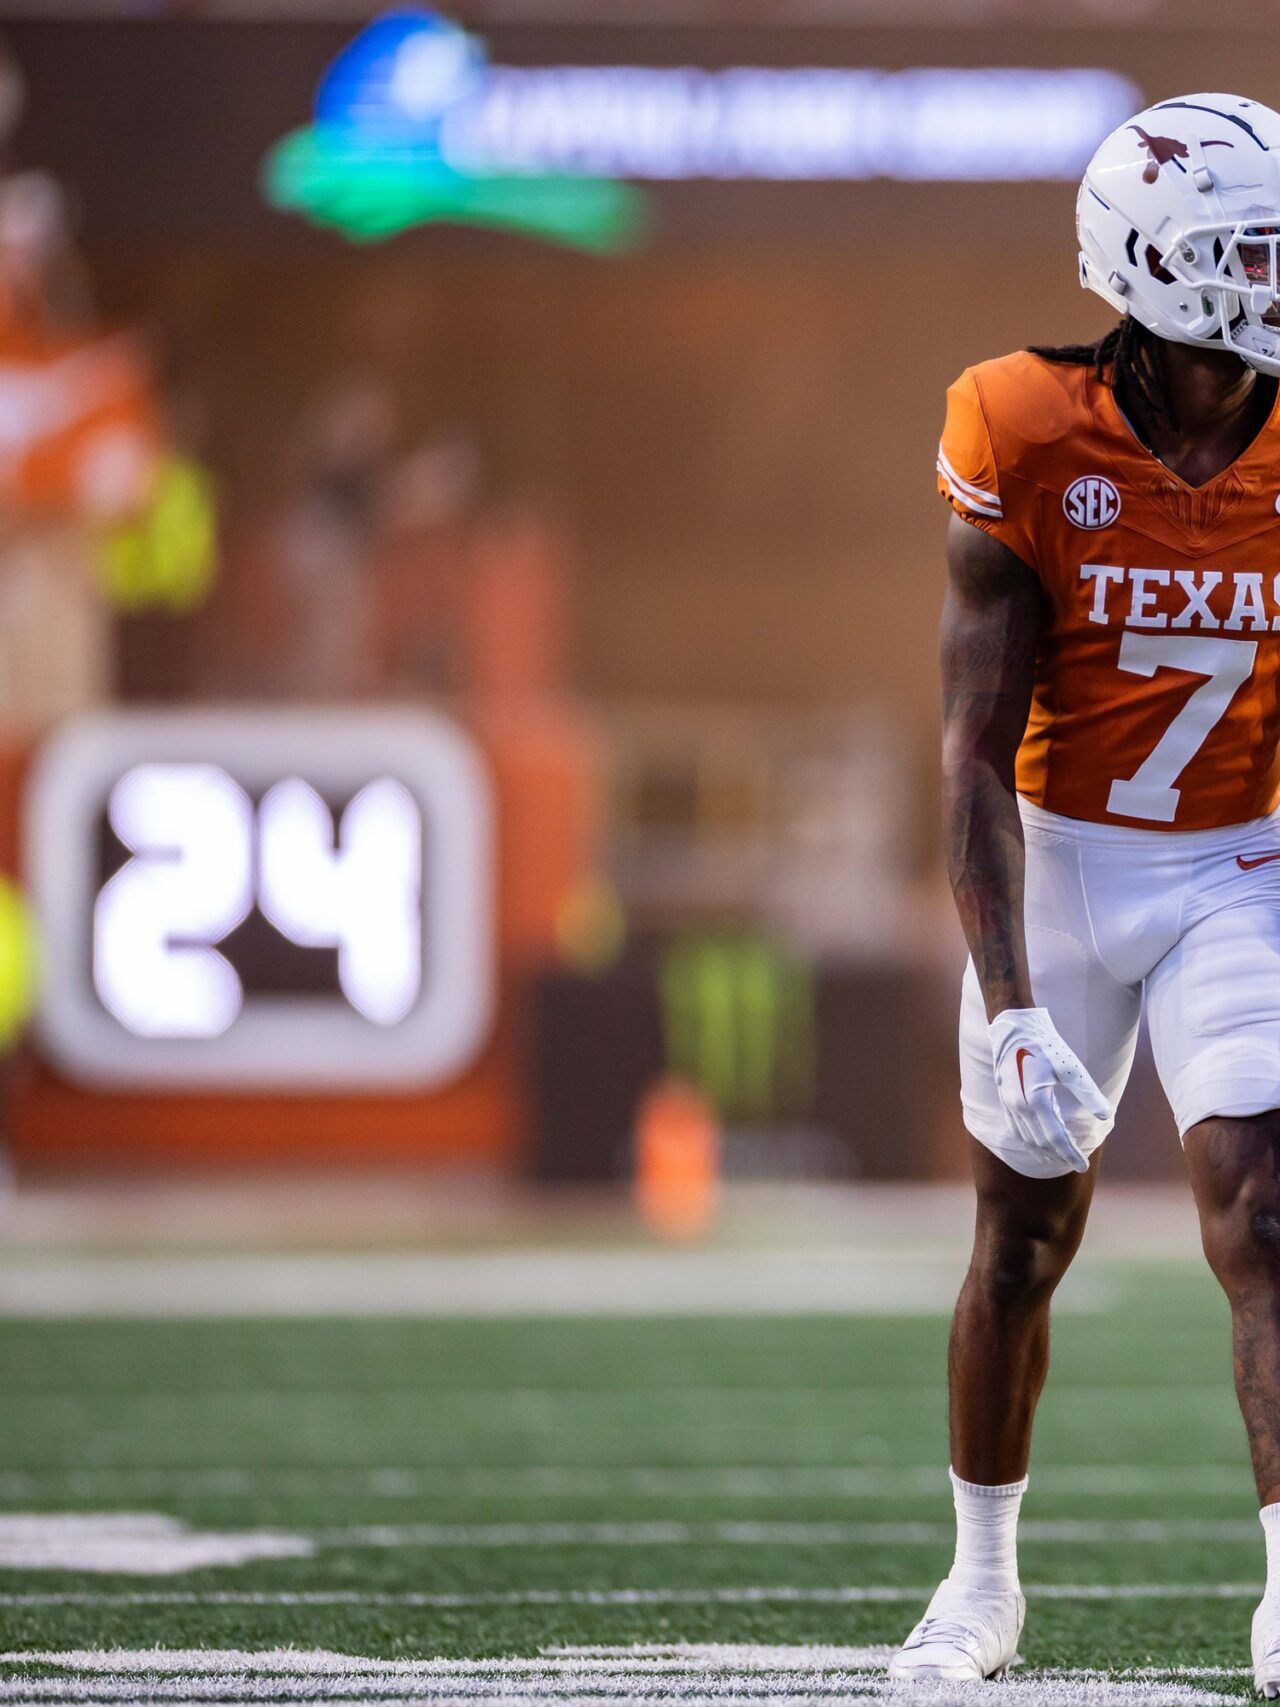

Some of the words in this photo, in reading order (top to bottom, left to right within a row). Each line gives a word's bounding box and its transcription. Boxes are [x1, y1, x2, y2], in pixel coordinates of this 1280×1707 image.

[1068, 479, 1116, 527] SEC
[1106, 631, 1258, 823] 7
[93, 762, 422, 1040] 24
